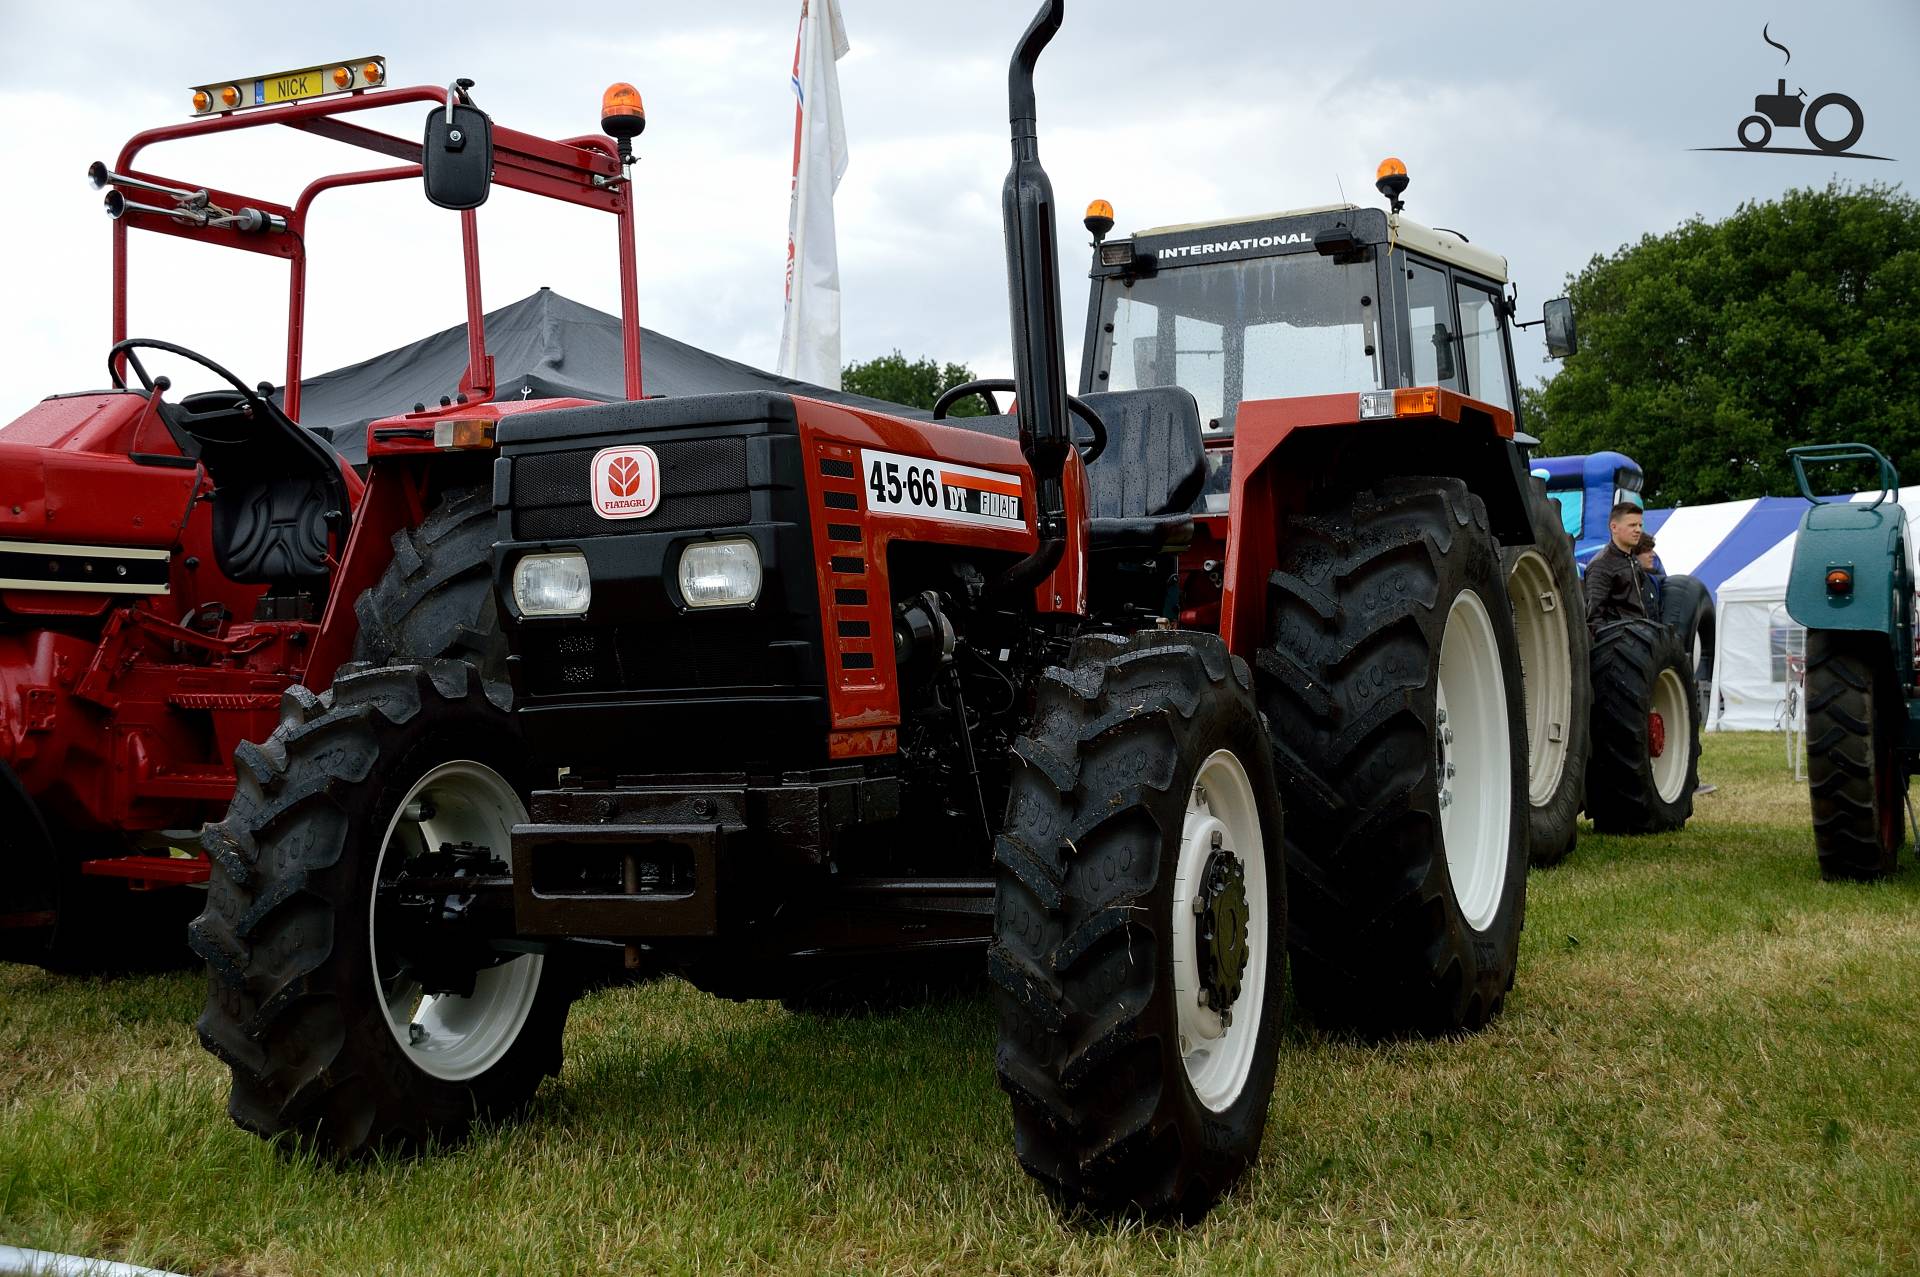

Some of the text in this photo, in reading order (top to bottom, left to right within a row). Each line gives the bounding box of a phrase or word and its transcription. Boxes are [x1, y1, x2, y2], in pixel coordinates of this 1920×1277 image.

[255, 76, 308, 103] NL NICK
[1158, 232, 1312, 259] INTERNATIONAL
[605, 498, 646, 510] FIATAGRI
[948, 486, 968, 512] DT
[981, 493, 1018, 519] FIAT
